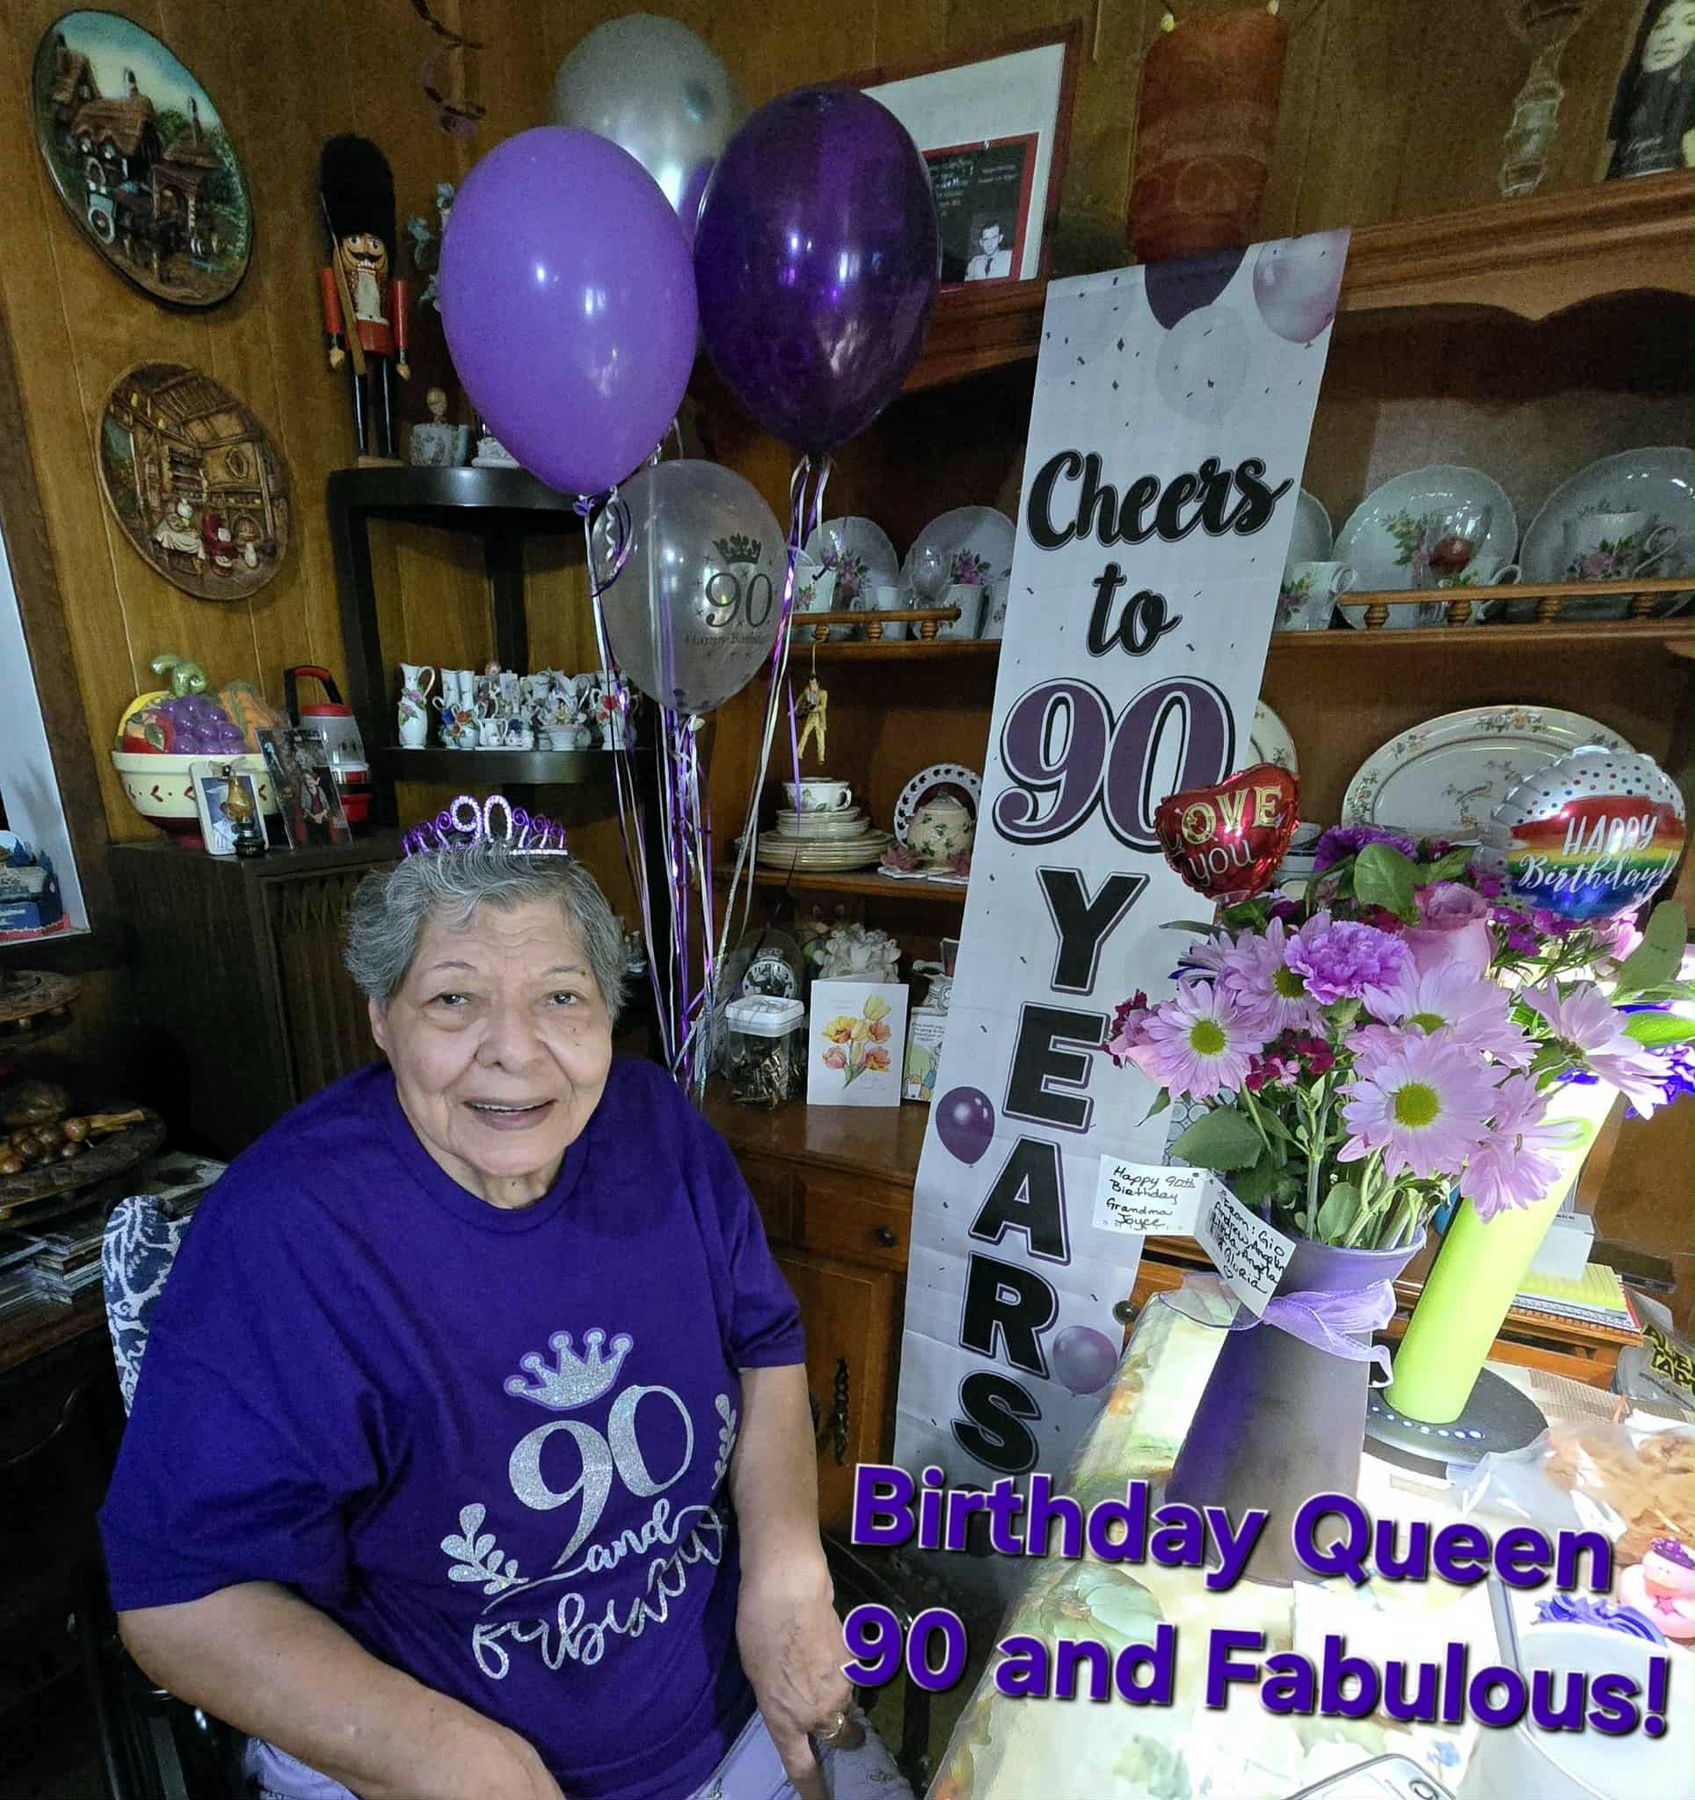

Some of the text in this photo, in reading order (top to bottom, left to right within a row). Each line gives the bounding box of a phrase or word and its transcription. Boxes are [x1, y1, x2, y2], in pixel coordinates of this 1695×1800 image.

[1027, 449, 1294, 551] Cheers
[705, 573, 773, 628] 90
[1086, 561, 1183, 658] to
[992, 675, 1237, 854] 90
[451, 794, 513, 845] 90
[1562, 814, 1658, 856] HAPPY
[1189, 840, 1257, 887] you
[1519, 850, 1680, 894] Birthday!
[950, 865, 1150, 1476] YEARS
[1113, 1166, 1196, 1190] Happy 90th
[1106, 1197, 1173, 1216] Grandma
[1115, 1213, 1166, 1230] Joyce
[1259, 1230, 1285, 1257] Gio
[508, 1384, 695, 1570] 90
[582, 1498, 692, 1573] and
